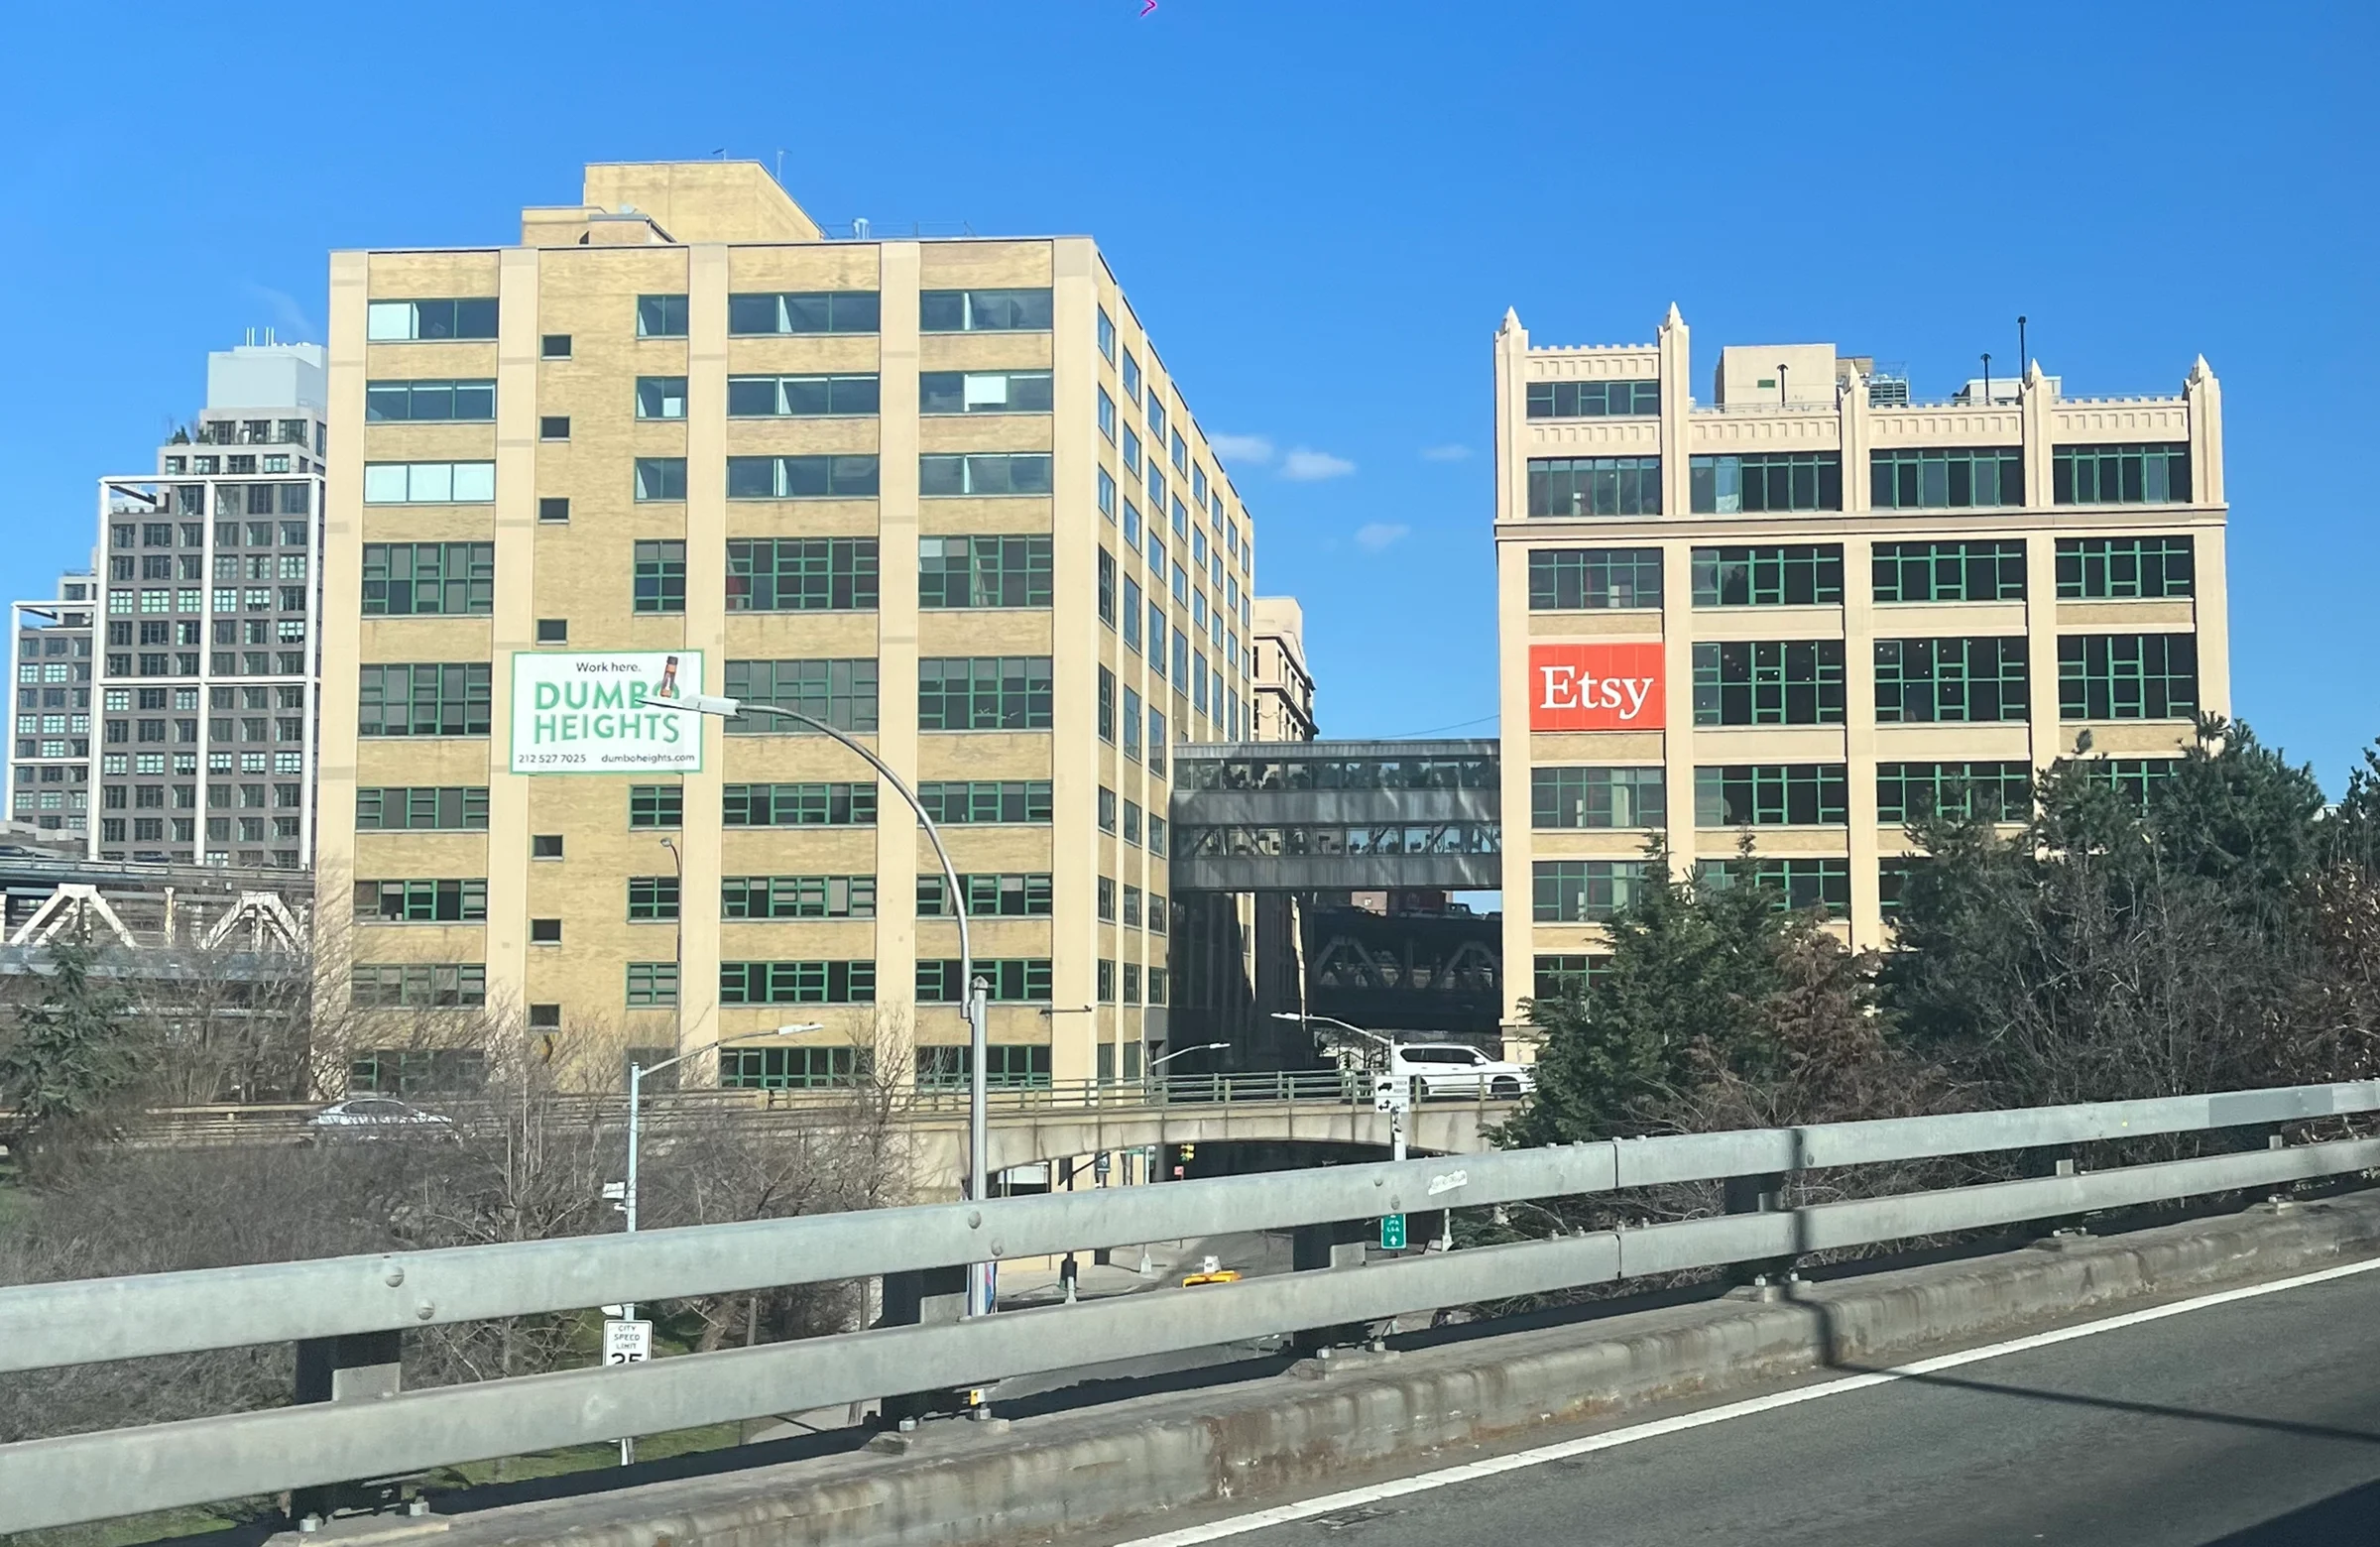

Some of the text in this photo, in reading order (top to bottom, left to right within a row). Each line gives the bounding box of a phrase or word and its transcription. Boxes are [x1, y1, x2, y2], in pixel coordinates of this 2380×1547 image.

[576, 661, 642, 672] Work here.
[1539, 665, 1654, 720] Etsy
[535, 713, 680, 744] HEIGHTS
[519, 754, 695, 764] 212 527 7025 dumboheights.com
